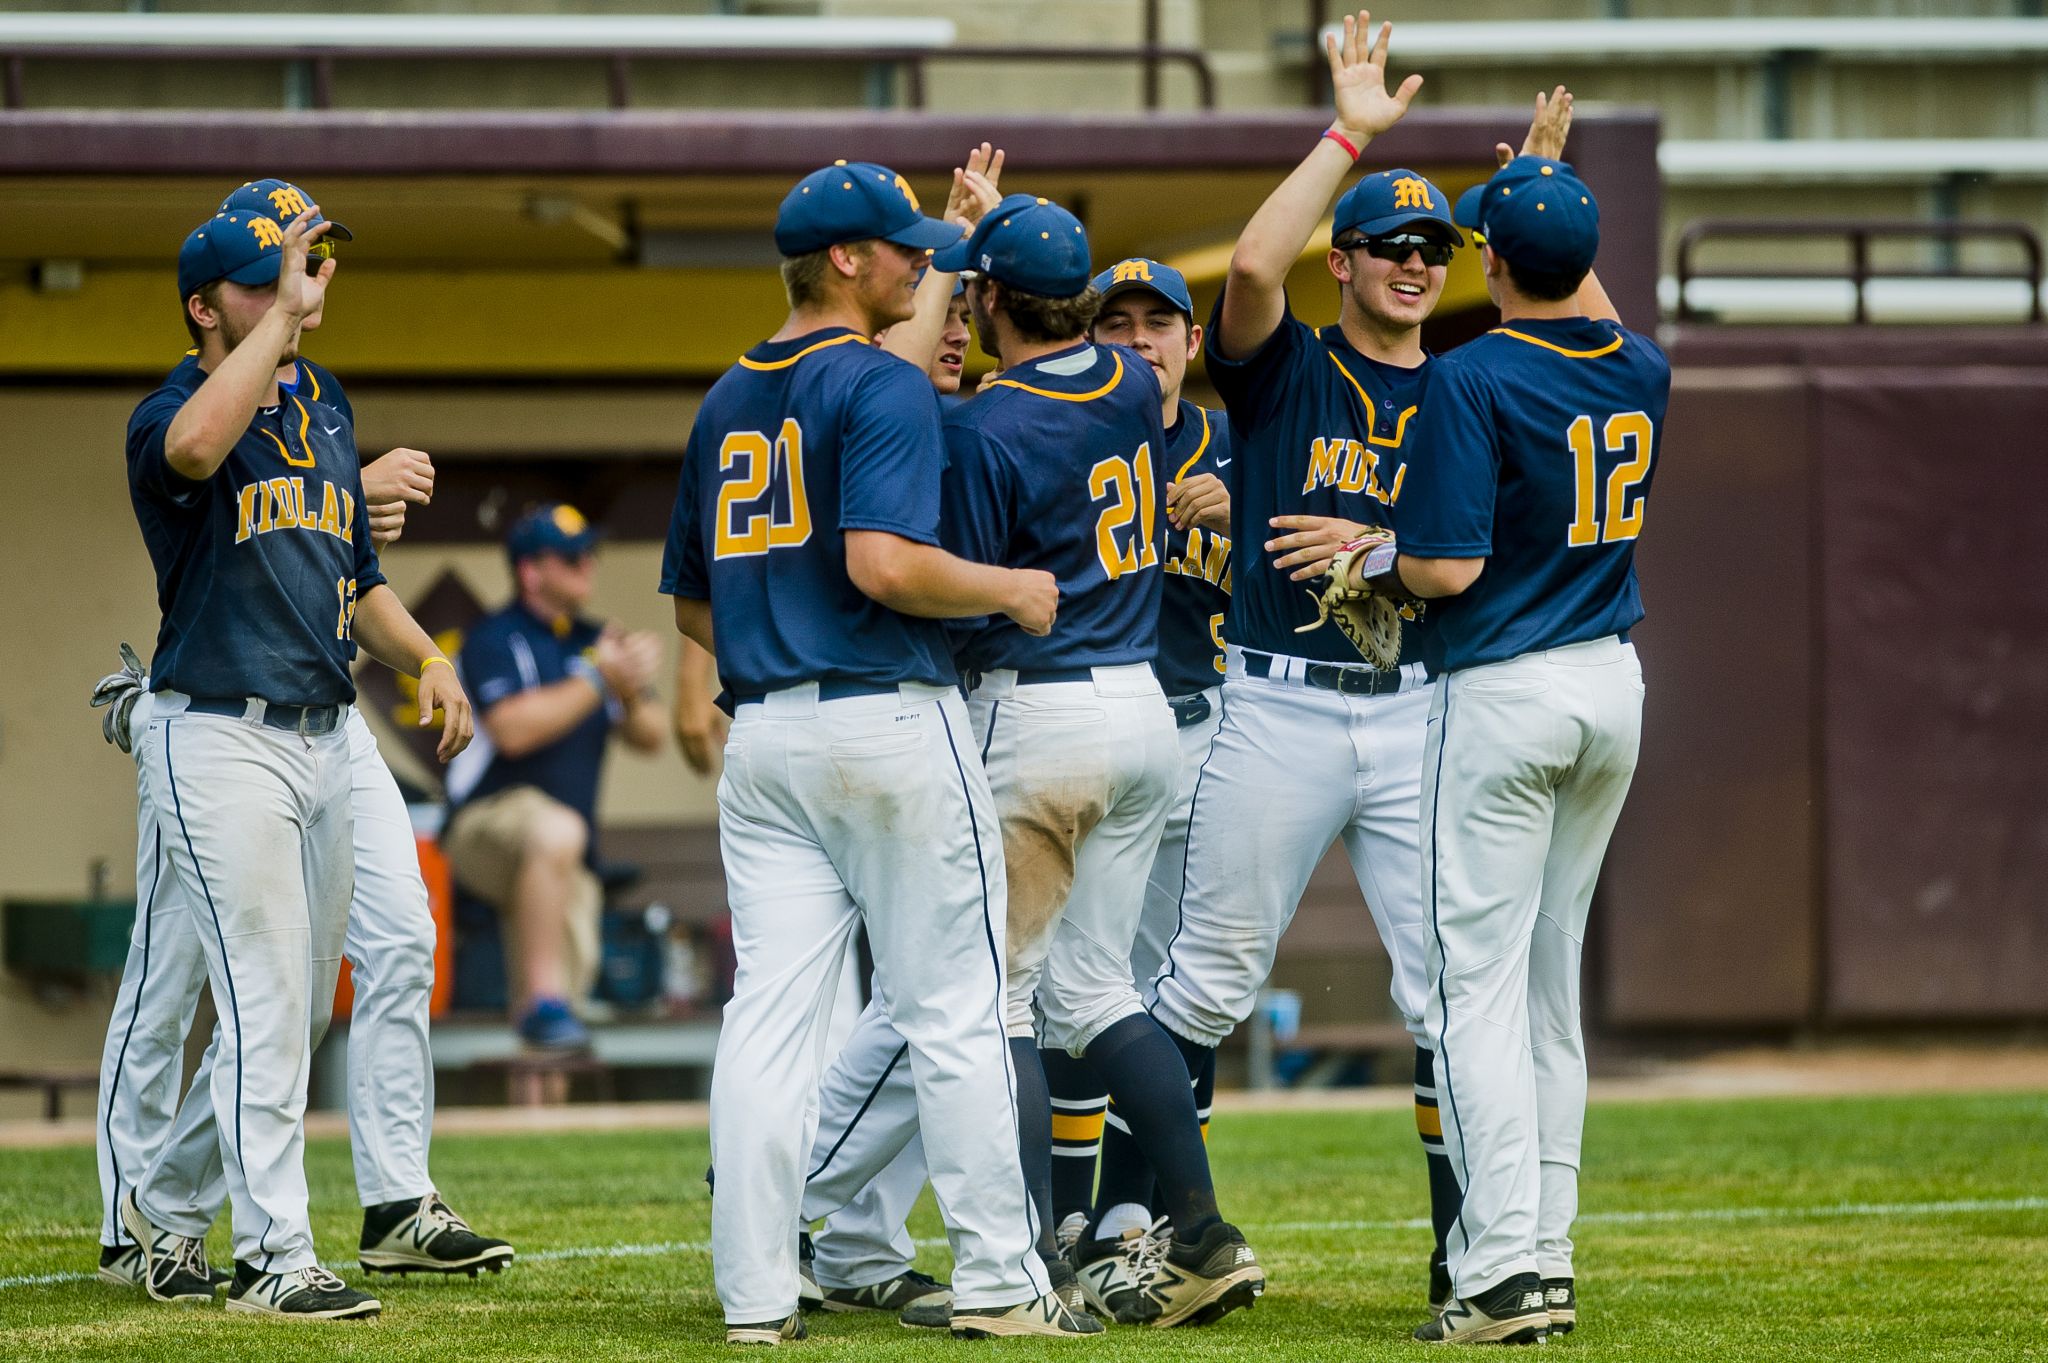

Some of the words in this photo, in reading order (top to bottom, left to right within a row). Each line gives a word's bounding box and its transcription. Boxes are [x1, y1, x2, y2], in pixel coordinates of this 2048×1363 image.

[714, 417, 813, 561] 20
[1088, 441, 1158, 580] 21
[1567, 410, 1653, 547] 12
